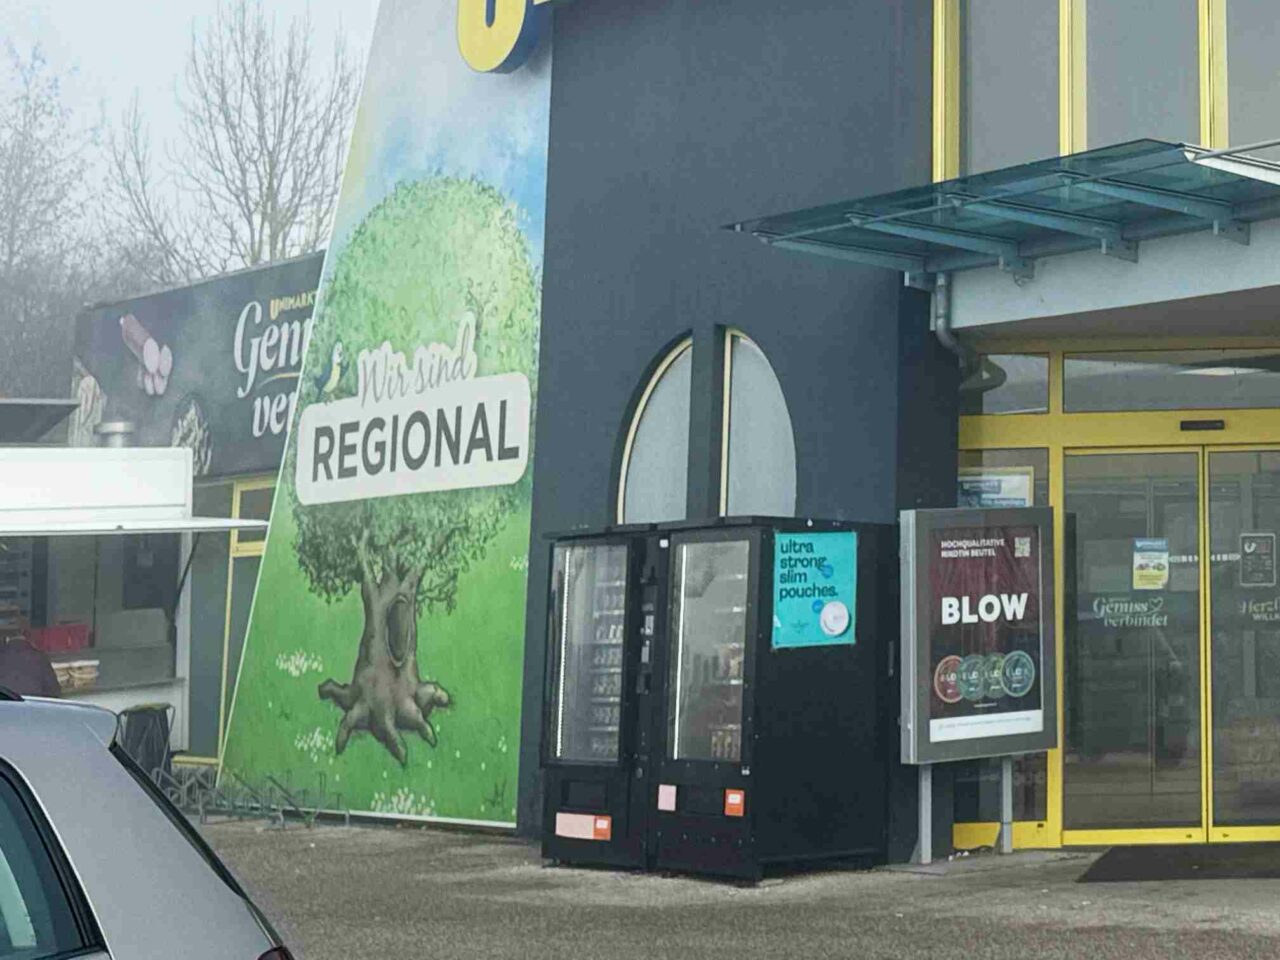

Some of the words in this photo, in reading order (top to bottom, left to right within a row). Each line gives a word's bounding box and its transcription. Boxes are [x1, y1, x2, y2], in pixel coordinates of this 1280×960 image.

[360, 352, 410, 408] Wir
[413, 320, 472, 394] sind
[312, 399, 520, 482] REGIONAL
[780, 539, 815, 554] ultra
[780, 555, 827, 573] strong
[780, 569, 808, 584] slim
[779, 582, 838, 602] pouches.
[941, 593, 1028, 625] BLOW
